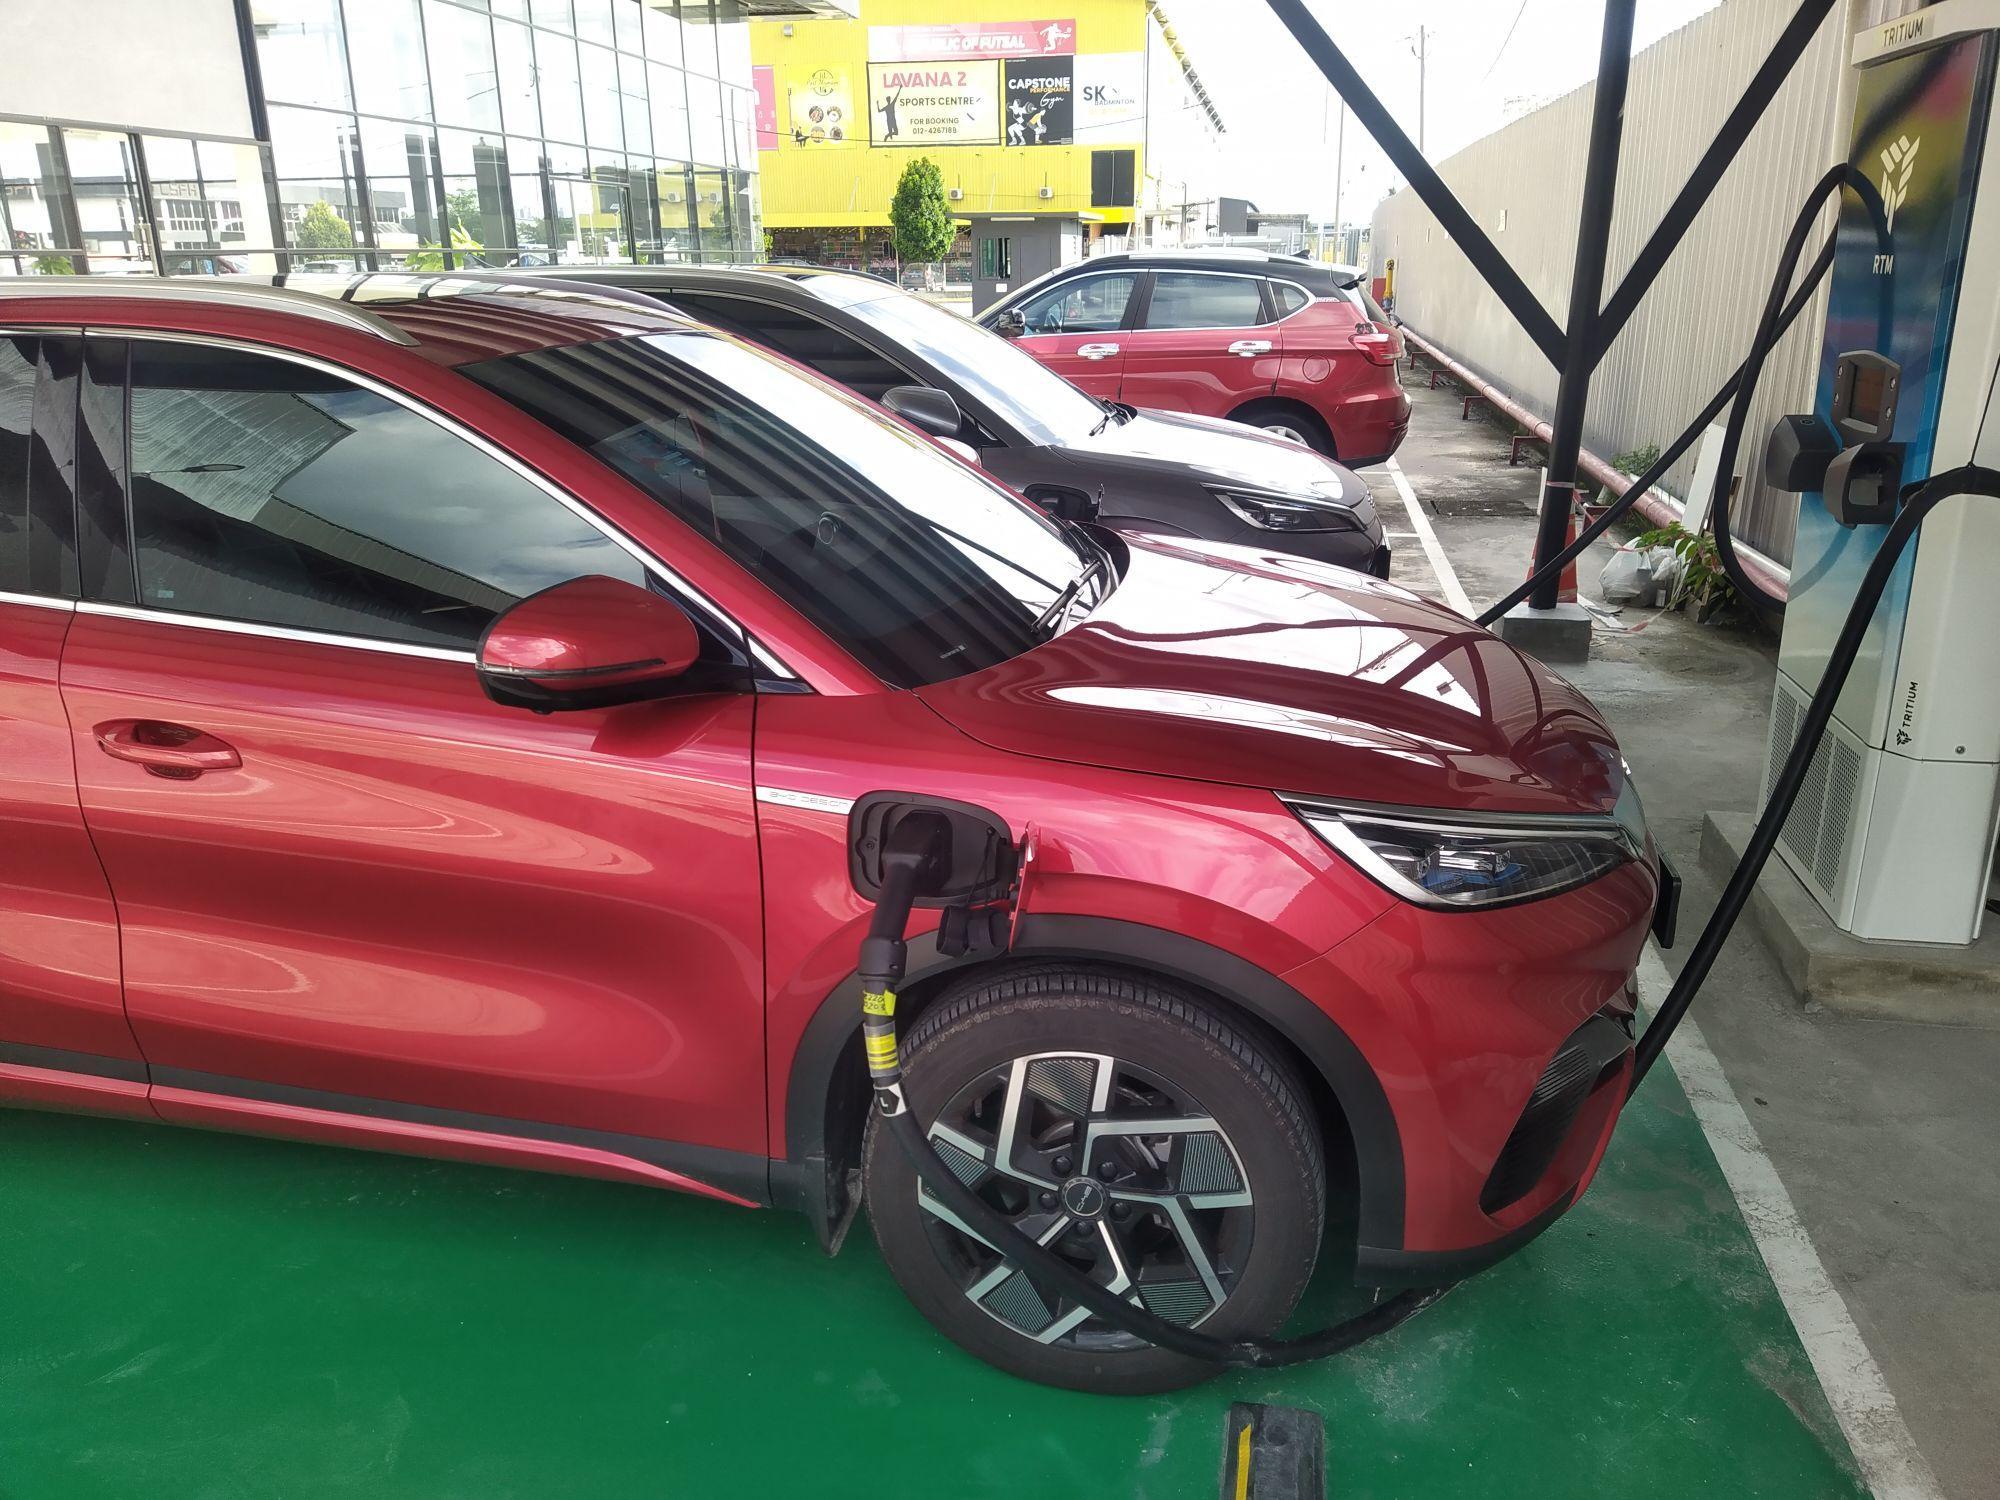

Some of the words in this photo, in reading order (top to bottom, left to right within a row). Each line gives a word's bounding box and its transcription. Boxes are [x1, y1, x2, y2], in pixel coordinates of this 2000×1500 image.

[1883, 16, 1923, 48] TRITIUM
[979, 34, 1025, 51] FUTSAL
[883, 71, 952, 88] LAVANA
[957, 71, 967, 87] 2
[1008, 77, 1070, 89] CAPSTONE
[1030, 86, 1070, 94] PERFORMANCE
[1083, 85, 1105, 101] SK
[900, 98, 936, 107] SPORTS
[938, 97, 974, 105] CENTRE
[1040, 91, 1064, 109] Gym
[1094, 98, 1135, 106] BADMINTON
[925, 117, 959, 125] BOOKING
[1873, 255, 1894, 275] RTM
[1902, 681, 1919, 727] TRITIUM
